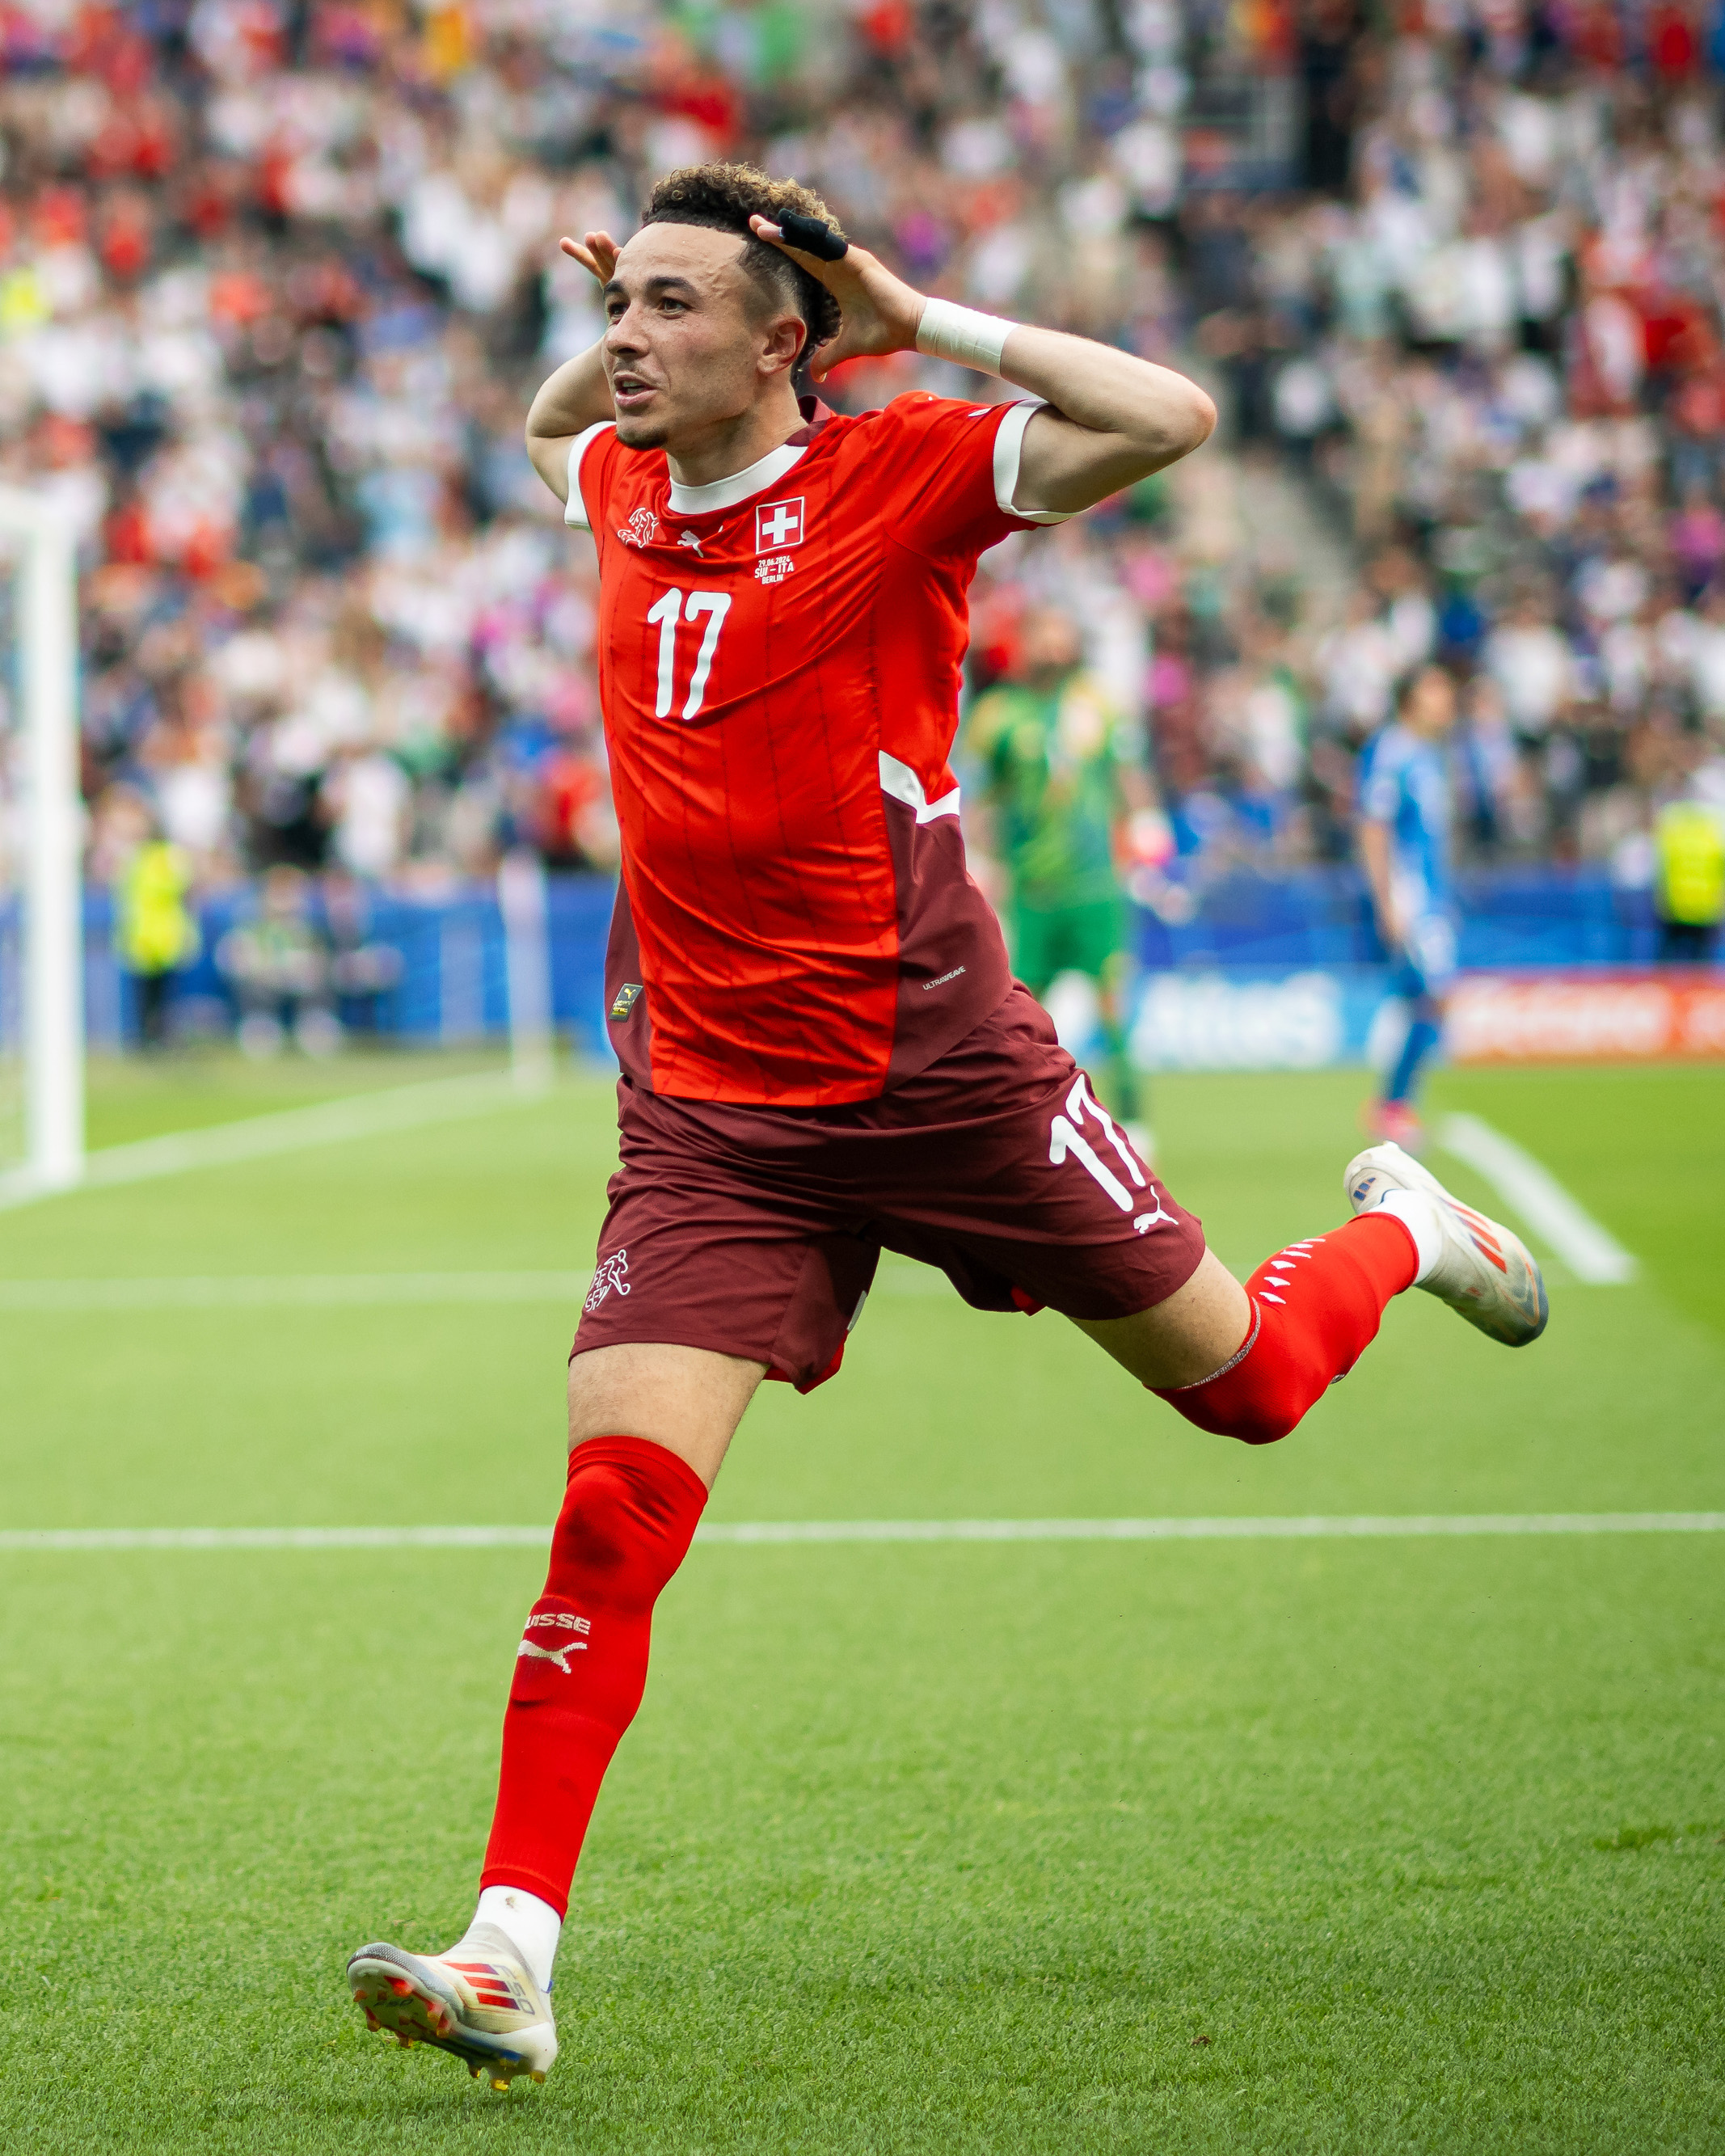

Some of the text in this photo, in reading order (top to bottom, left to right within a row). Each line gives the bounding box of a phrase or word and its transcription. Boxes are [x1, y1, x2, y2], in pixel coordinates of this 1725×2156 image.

[754, 567, 768, 578] SUI
[778, 562, 794, 573] ITA
[761, 574, 783, 584] BERLIN
[647, 587, 732, 720] 17
[922, 965, 966, 990] ULTRAWEAVE
[1049, 1074, 1146, 1212] 17
